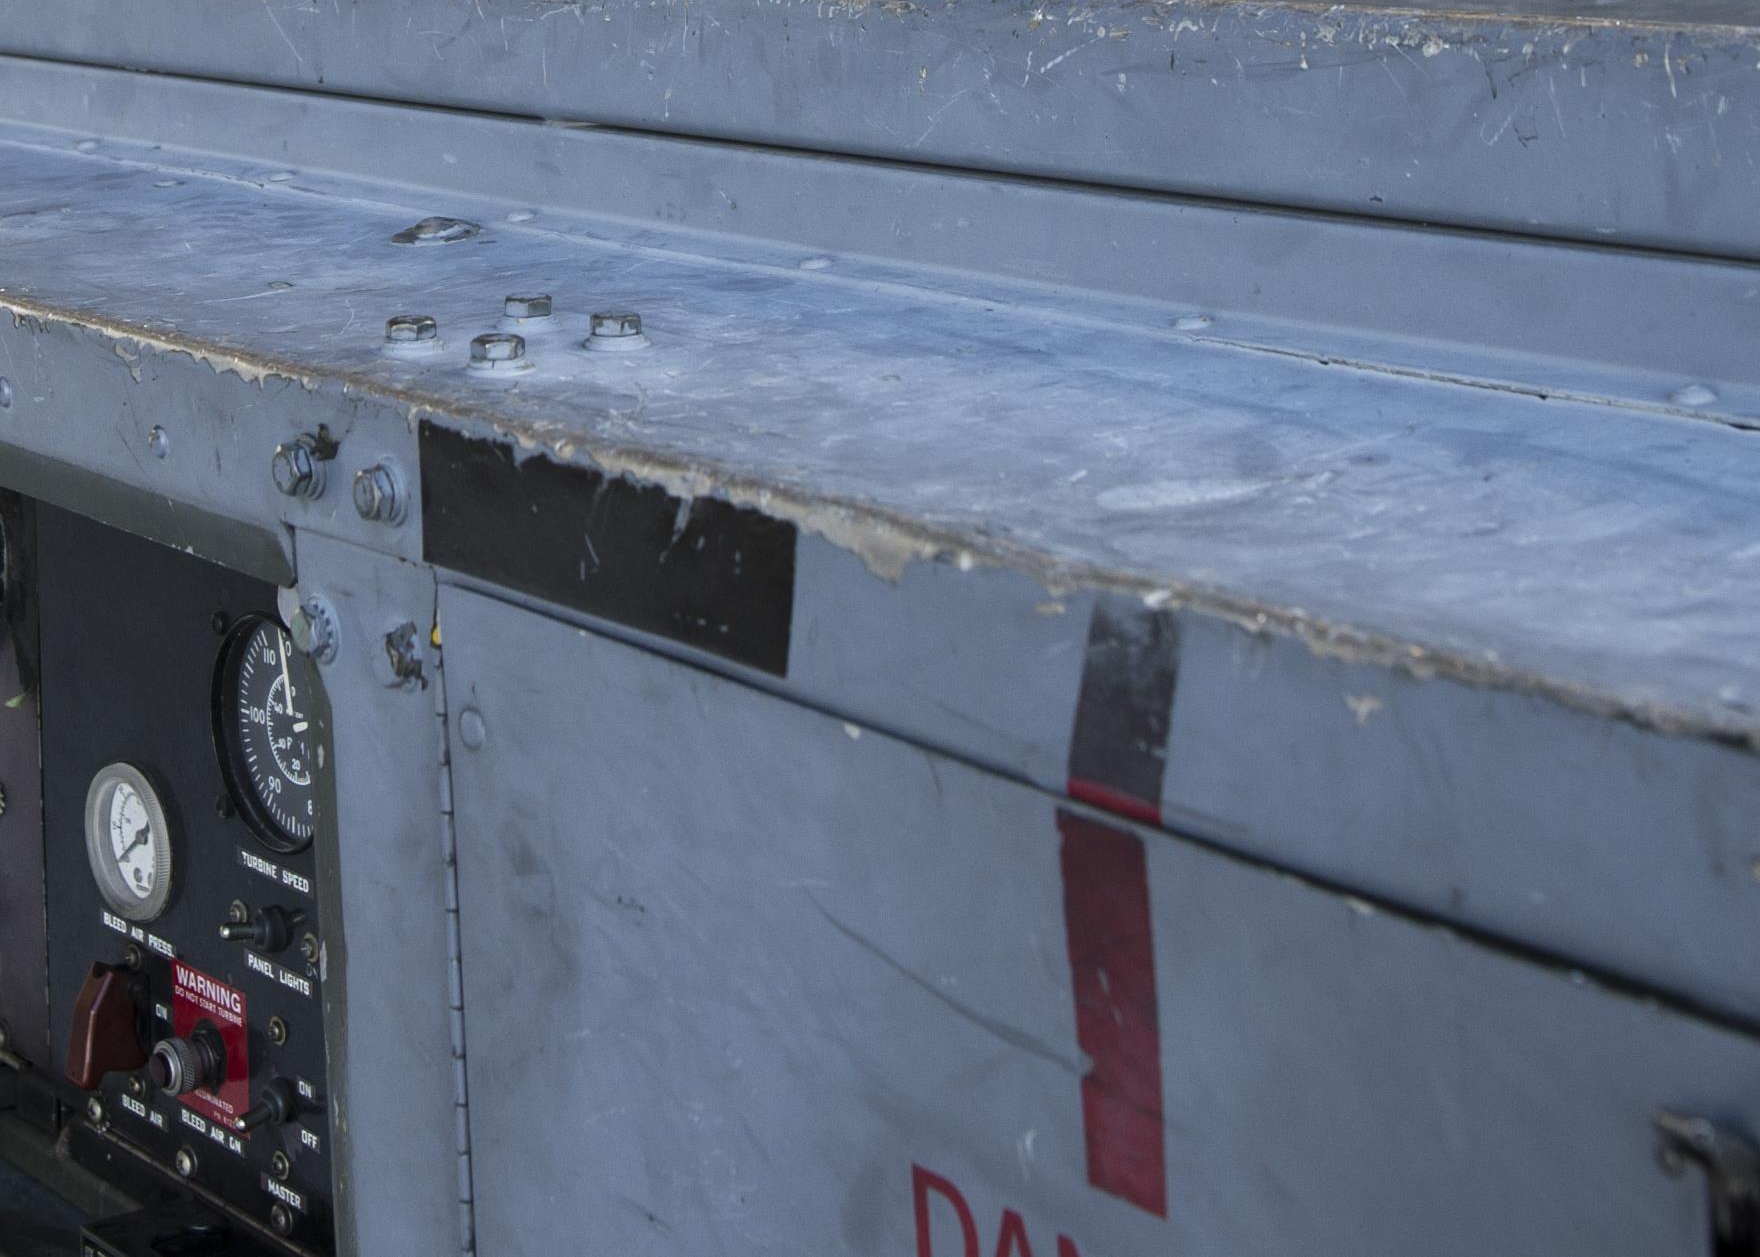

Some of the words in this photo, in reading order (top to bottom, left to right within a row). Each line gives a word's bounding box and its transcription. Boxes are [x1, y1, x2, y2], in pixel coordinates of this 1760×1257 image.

[263, 648, 276, 665] 110
[250, 706, 266, 725] 100
[268, 775, 282, 794] 90
[241, 851, 277, 879] TURBINE
[282, 865, 310, 893] SPEED
[103, 910, 127, 934] BLEED
[131, 925, 144, 942] AIR
[176, 965, 242, 1014] WARNING
[248, 954, 274, 980] PANEL
[279, 968, 310, 996] LIGHTS
[155, 1003, 168, 1021] ON
[175, 985, 185, 998] DO
[185, 991, 199, 1005] NOT
[199, 997, 217, 1013] START
[217, 1006, 243, 1027] TURBINE
[298, 1079, 312, 1098] ON
[122, 1094, 146, 1118] BLEED
[150, 1110, 163, 1128] AIR
[181, 1108, 206, 1133] BLEED
[210, 1126, 225, 1144] AIR
[229, 1136, 242, 1153] ON
[301, 1129, 318, 1149] OFF
[267, 1179, 302, 1209] MASTER
